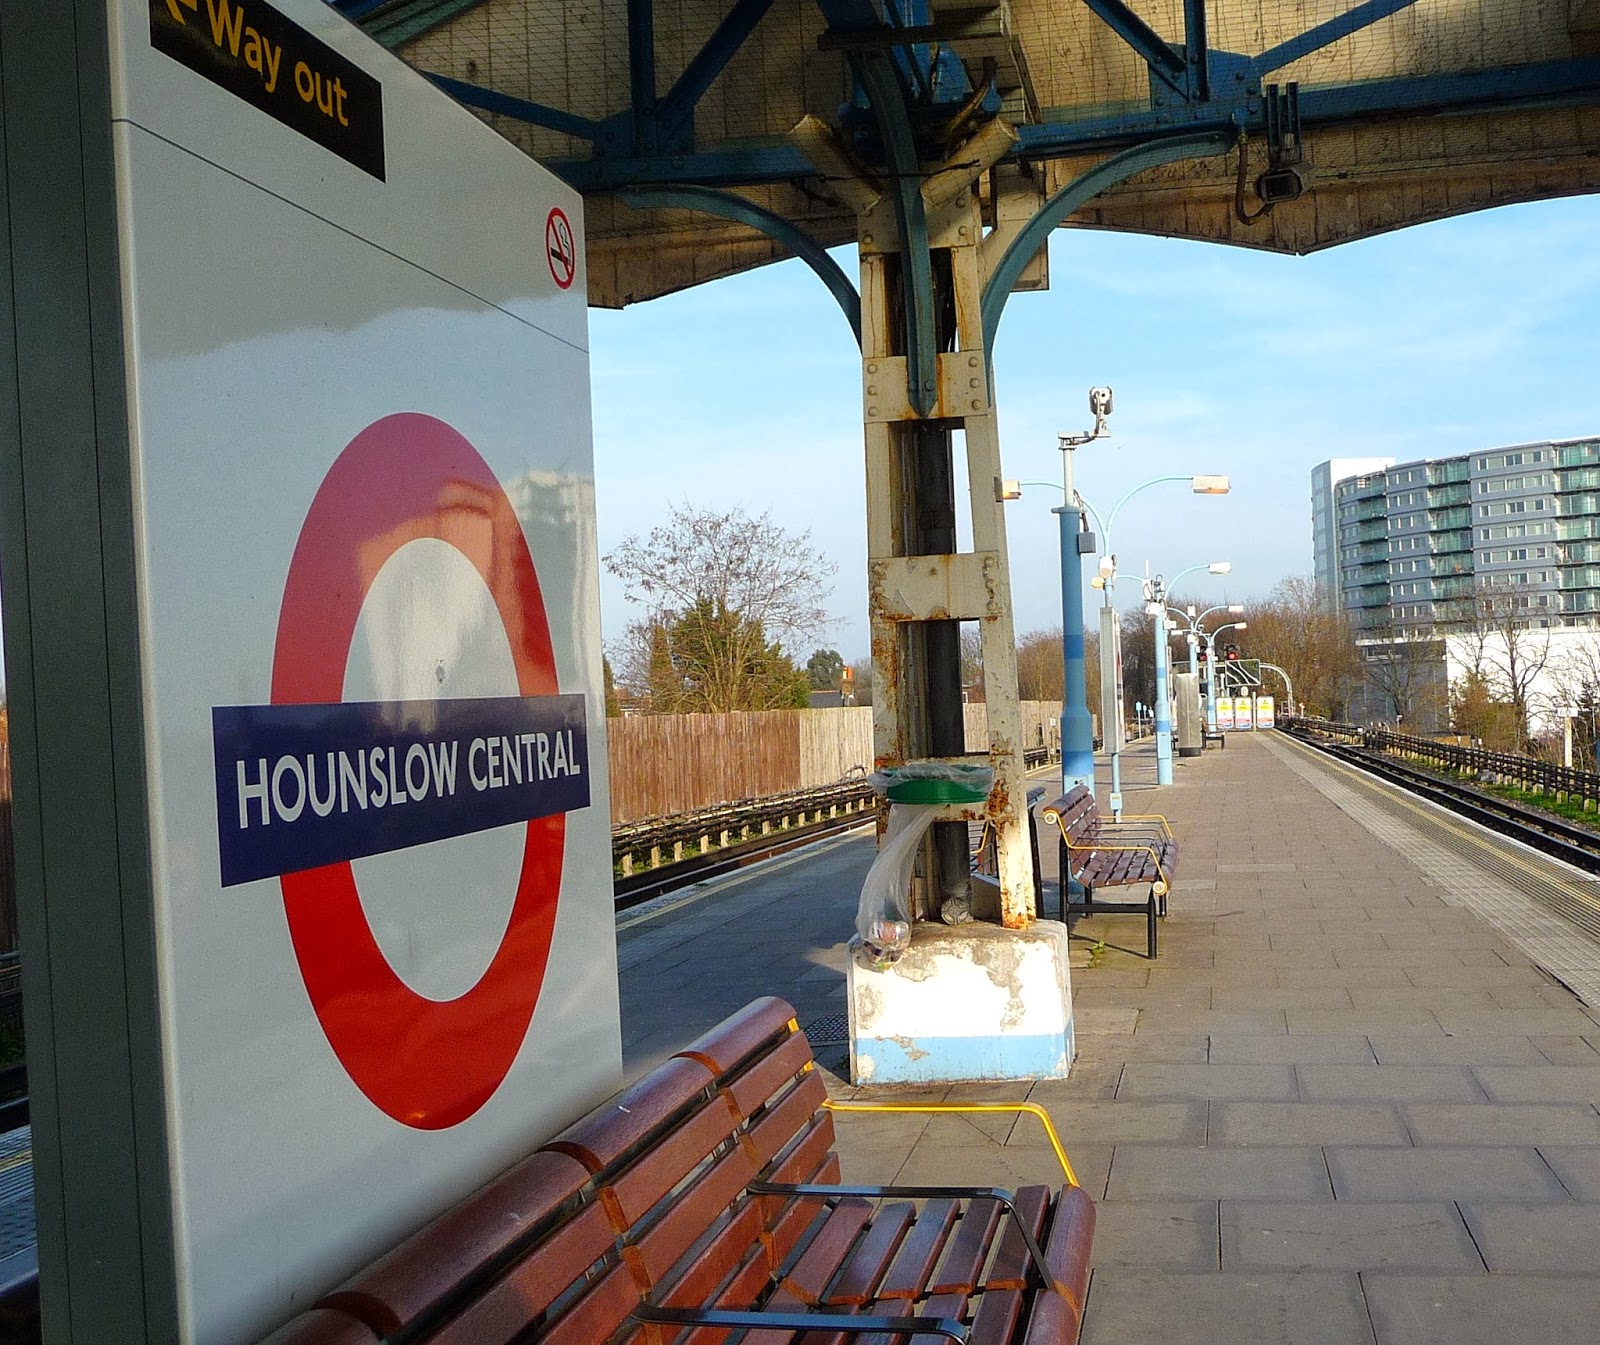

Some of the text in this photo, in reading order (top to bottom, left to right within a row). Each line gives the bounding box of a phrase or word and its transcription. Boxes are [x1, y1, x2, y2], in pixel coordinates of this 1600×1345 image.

[207, 0, 348, 126] Way out
[237, 730, 580, 828] HOUNSLOW CENTRAL
